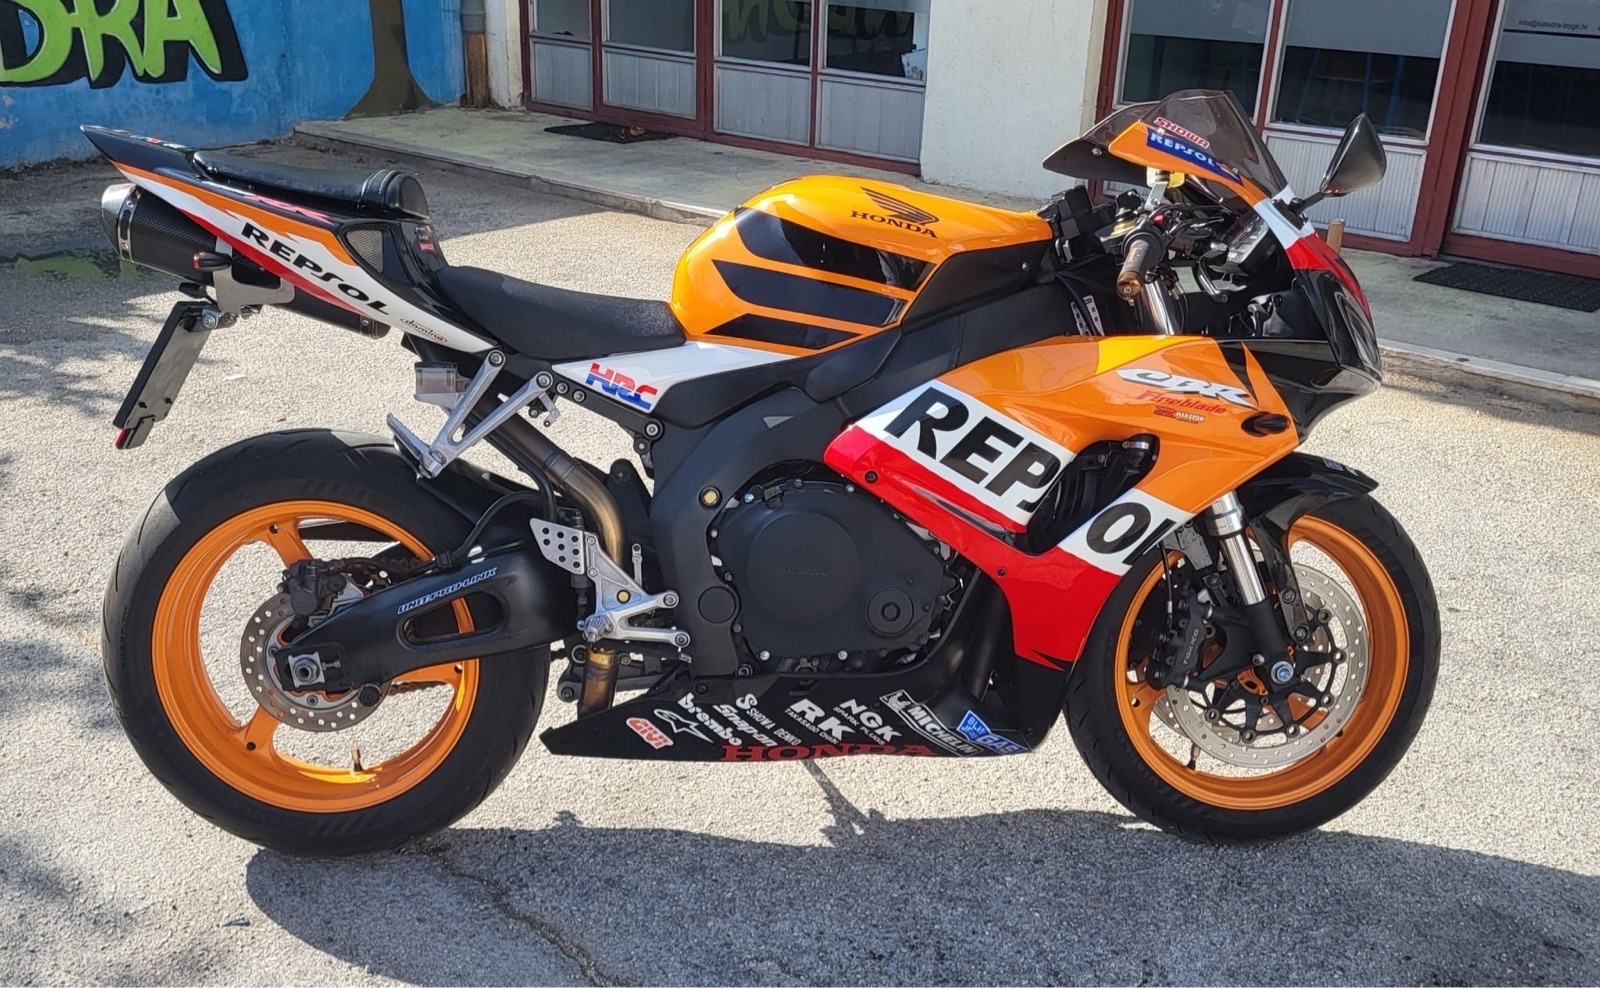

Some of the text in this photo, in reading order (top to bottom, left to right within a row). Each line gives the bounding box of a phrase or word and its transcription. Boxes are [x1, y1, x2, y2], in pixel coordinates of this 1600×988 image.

[1149, 132, 1216, 166] REPSOL
[850, 210, 938, 239] HONDA
[241, 222, 389, 316] REPSOL
[585, 362, 658, 411] HRC
[1115, 368, 1259, 412] CBR
[1135, 390, 1227, 414] Fireblade
[678, 693, 742, 746] brembo
[746, 707, 776, 730] SHOWA
[784, 708, 820, 733] TAKASAGO
[789, 698, 856, 741] RK
[839, 699, 902, 743] NGK
[907, 706, 979, 753] MICHELIN
[720, 743, 937, 761] HONDA
